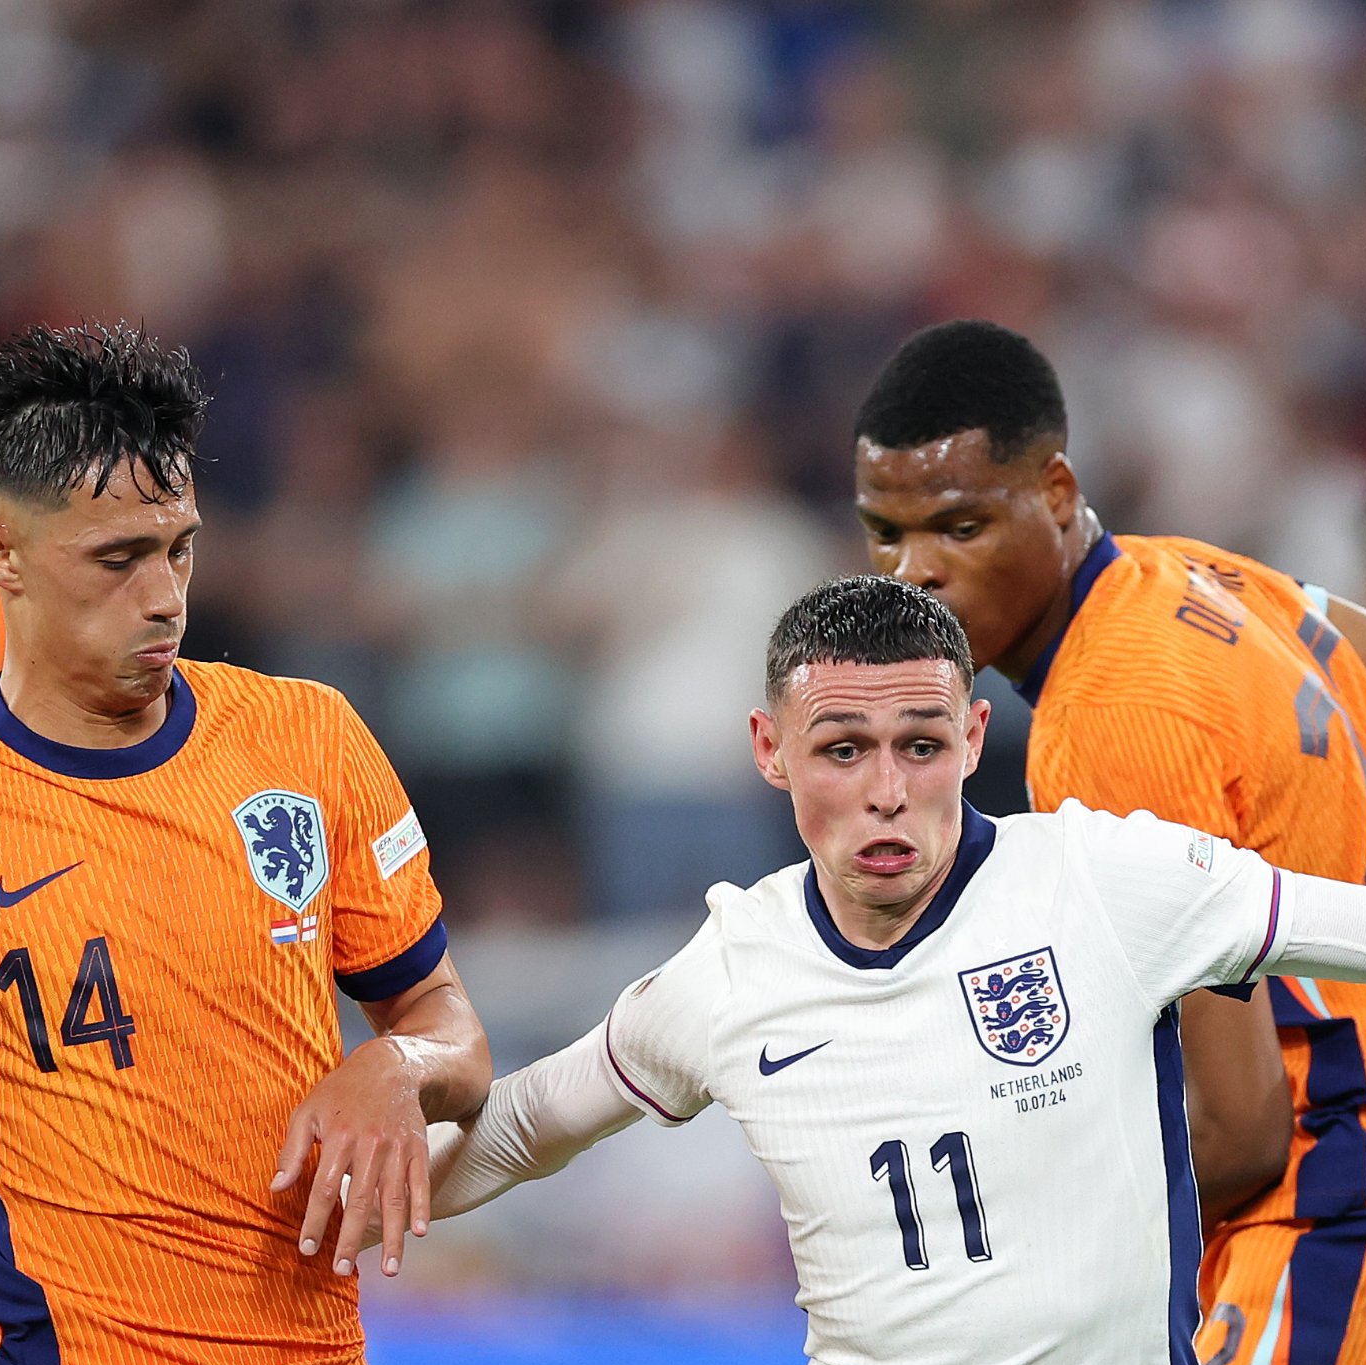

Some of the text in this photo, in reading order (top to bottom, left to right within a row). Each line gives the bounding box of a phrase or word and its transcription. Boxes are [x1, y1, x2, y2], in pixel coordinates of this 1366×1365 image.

[256, 798, 286, 809] KNVB
[990, 1063, 1083, 1099] NETHERLANDS
[1015, 1089, 1066, 1113] 10.07.24
[869, 1131, 992, 1271] 11
